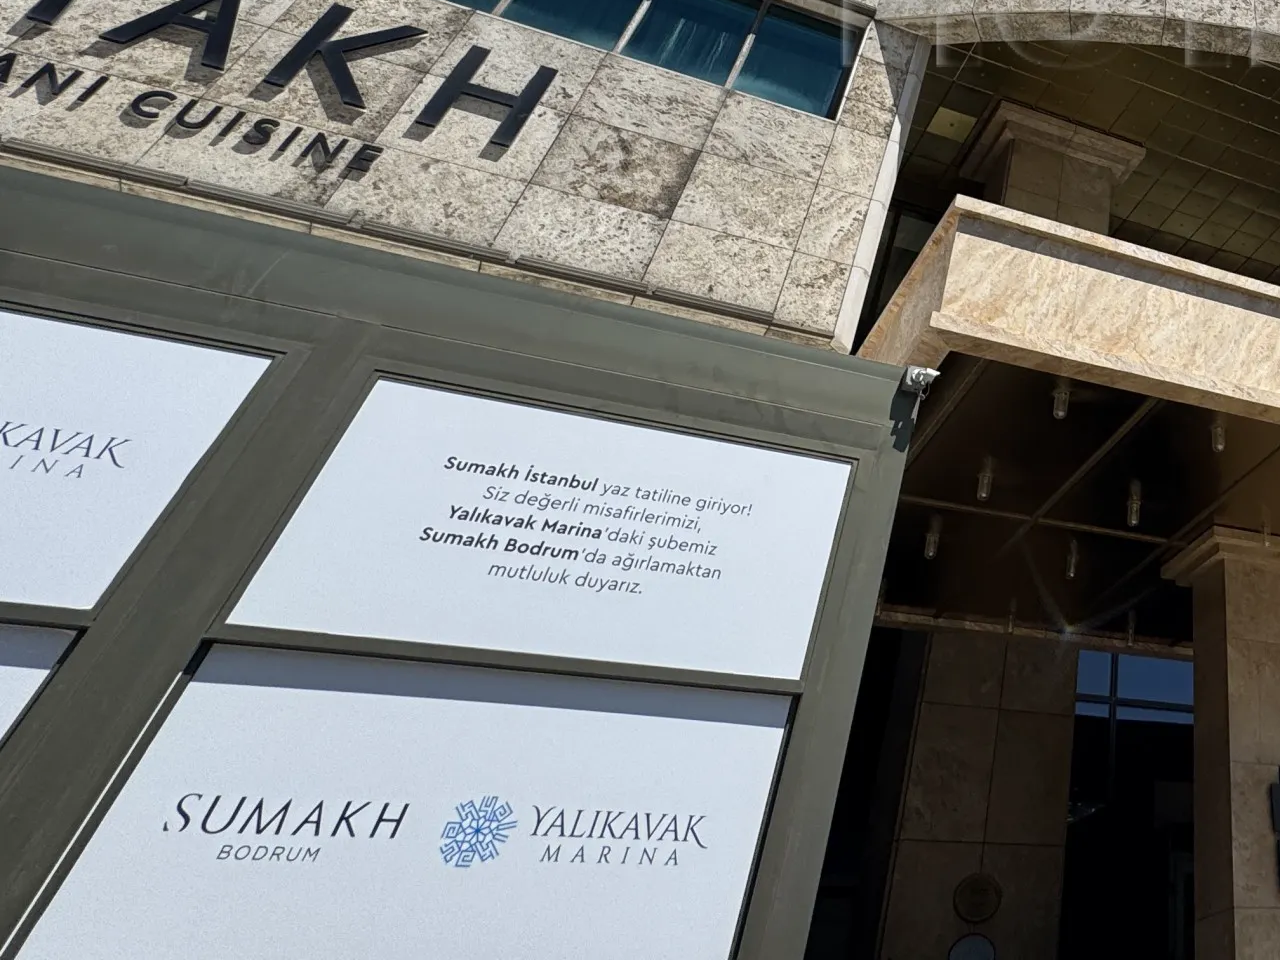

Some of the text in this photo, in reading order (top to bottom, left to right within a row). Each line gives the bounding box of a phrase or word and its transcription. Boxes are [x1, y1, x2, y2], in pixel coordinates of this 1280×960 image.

[131, 90, 383, 173] CUISINE
[9, 455, 84, 478] INA
[443, 456, 753, 517] Sumakh İstanbul yaz tatiline giriyor!
[449, 505, 718, 556] Yalıkavak Marina'daki şubemiz
[482, 486, 702, 534] Siz değerli misafirlerimizi,
[419, 527, 722, 580] Sumakh Bodrum'da ağırlamaktan
[488, 564, 643, 595] mutluluk duyarız.
[162, 793, 411, 839] SUMAKH
[530, 805, 708, 849] YALIKAVAK
[216, 844, 321, 863] BODRUM
[539, 844, 679, 866] MARINA
